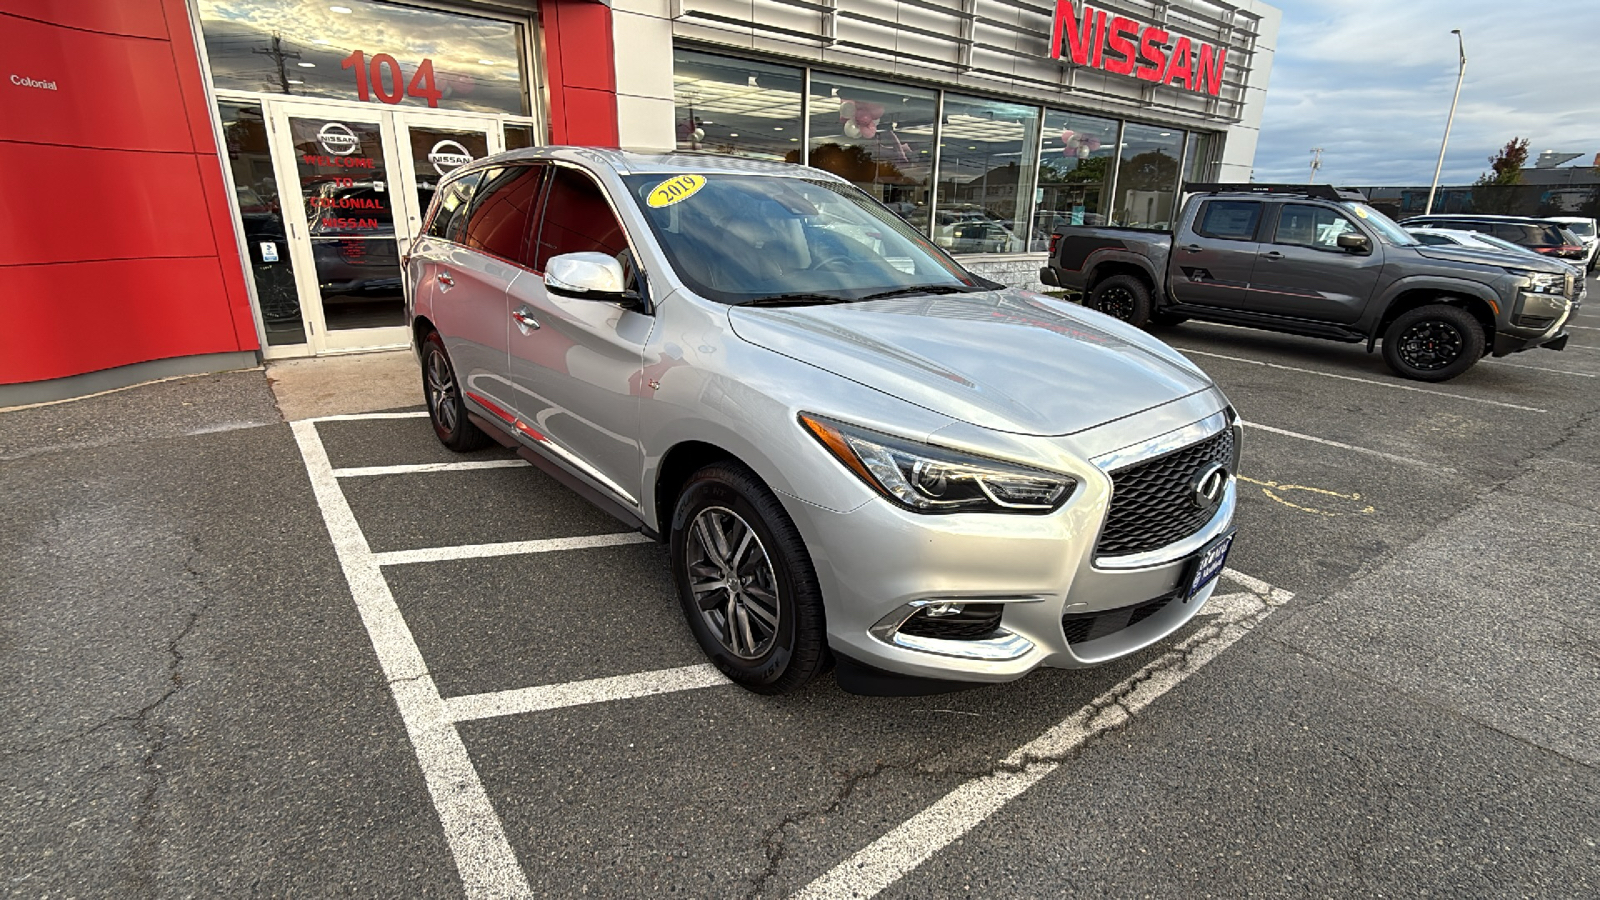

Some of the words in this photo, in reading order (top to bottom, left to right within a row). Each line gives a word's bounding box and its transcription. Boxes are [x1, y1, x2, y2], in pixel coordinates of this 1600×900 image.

[1051, 0, 1227, 96] NISSAN
[10, 74, 58, 91] Colonial
[341, 49, 443, 108] 104
[320, 135, 356, 144] NISSAN
[302, 154, 376, 169] WELCOME
[432, 156, 470, 164] NISSAN
[332, 177, 354, 189] TO
[658, 176, 696, 203] 2019
[309, 196, 384, 209] COLONIAL
[321, 217, 379, 229] NISSAN
